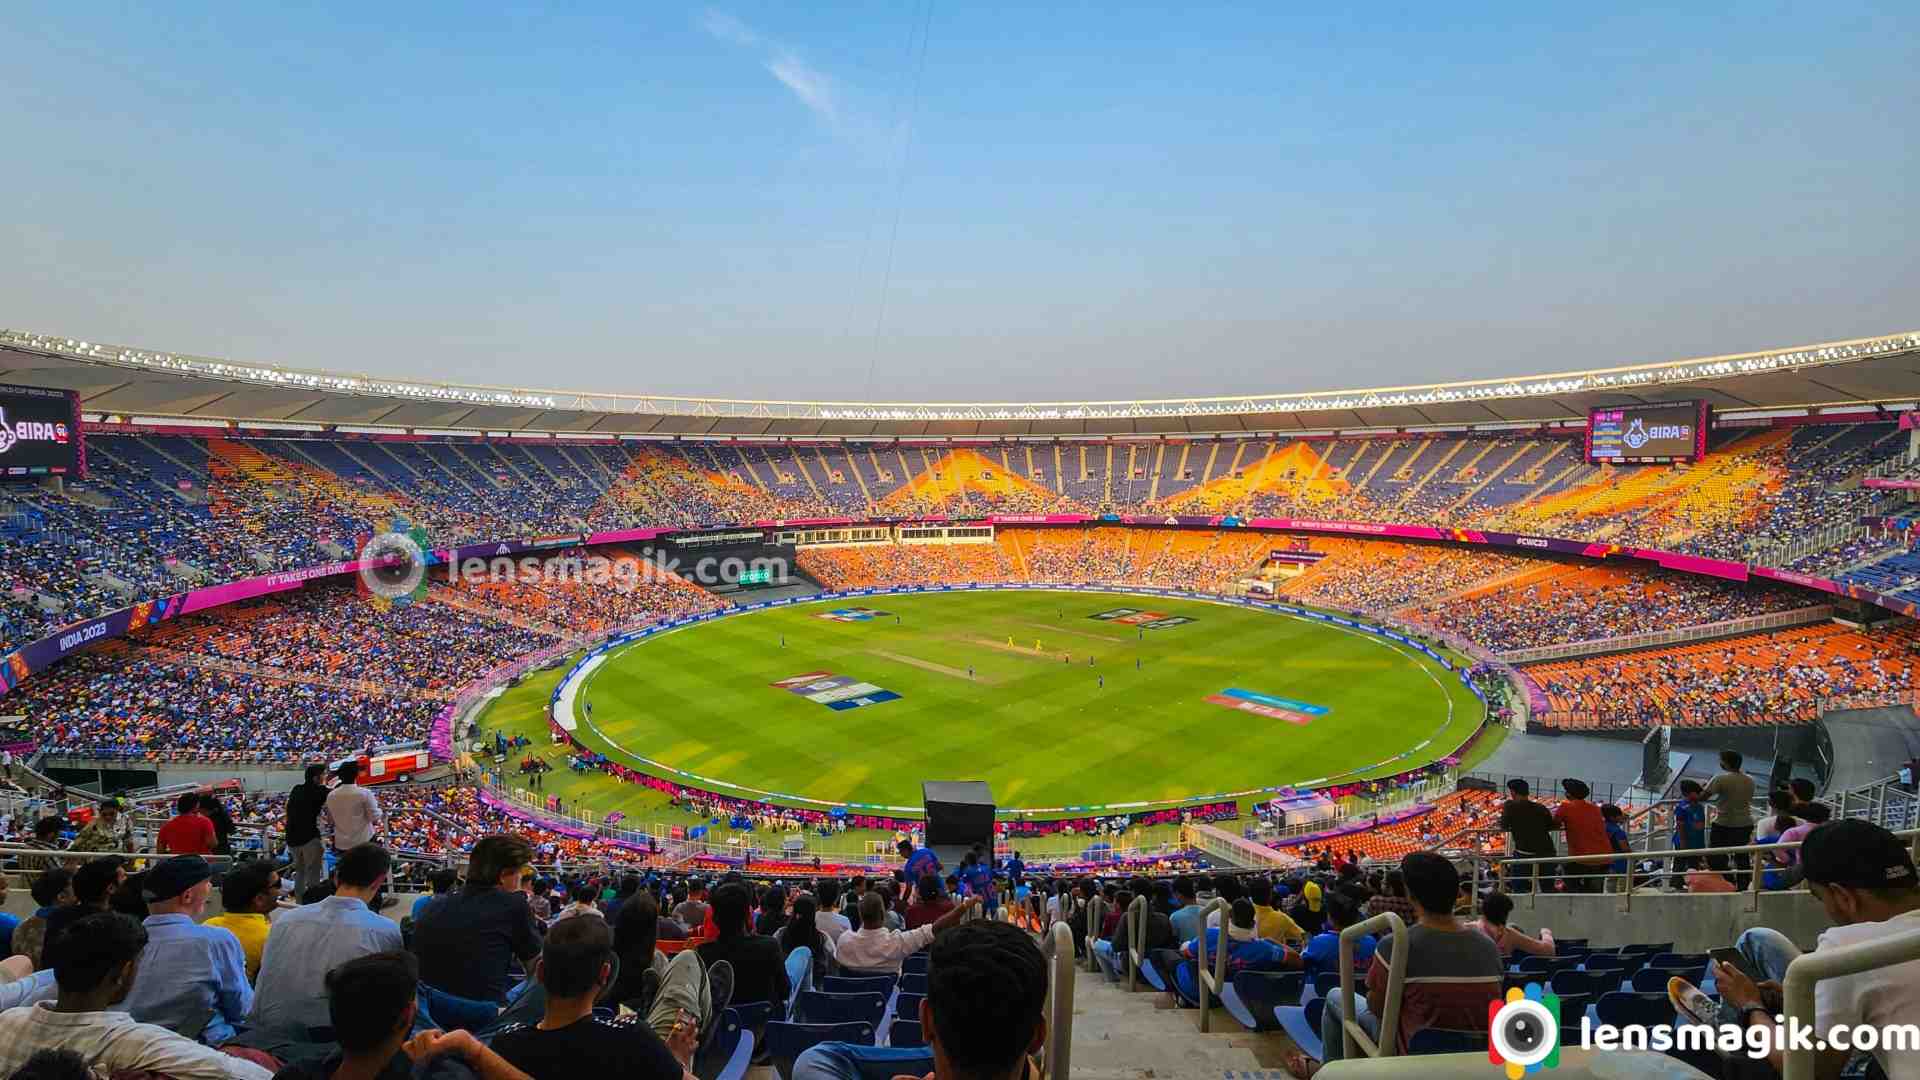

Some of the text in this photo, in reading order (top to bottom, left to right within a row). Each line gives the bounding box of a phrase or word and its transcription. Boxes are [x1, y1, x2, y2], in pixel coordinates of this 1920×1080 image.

[16, 421, 56, 440] BIRA
[1649, 426, 1680, 439] BIRA
[60, 622, 106, 651] INDIA 2023
